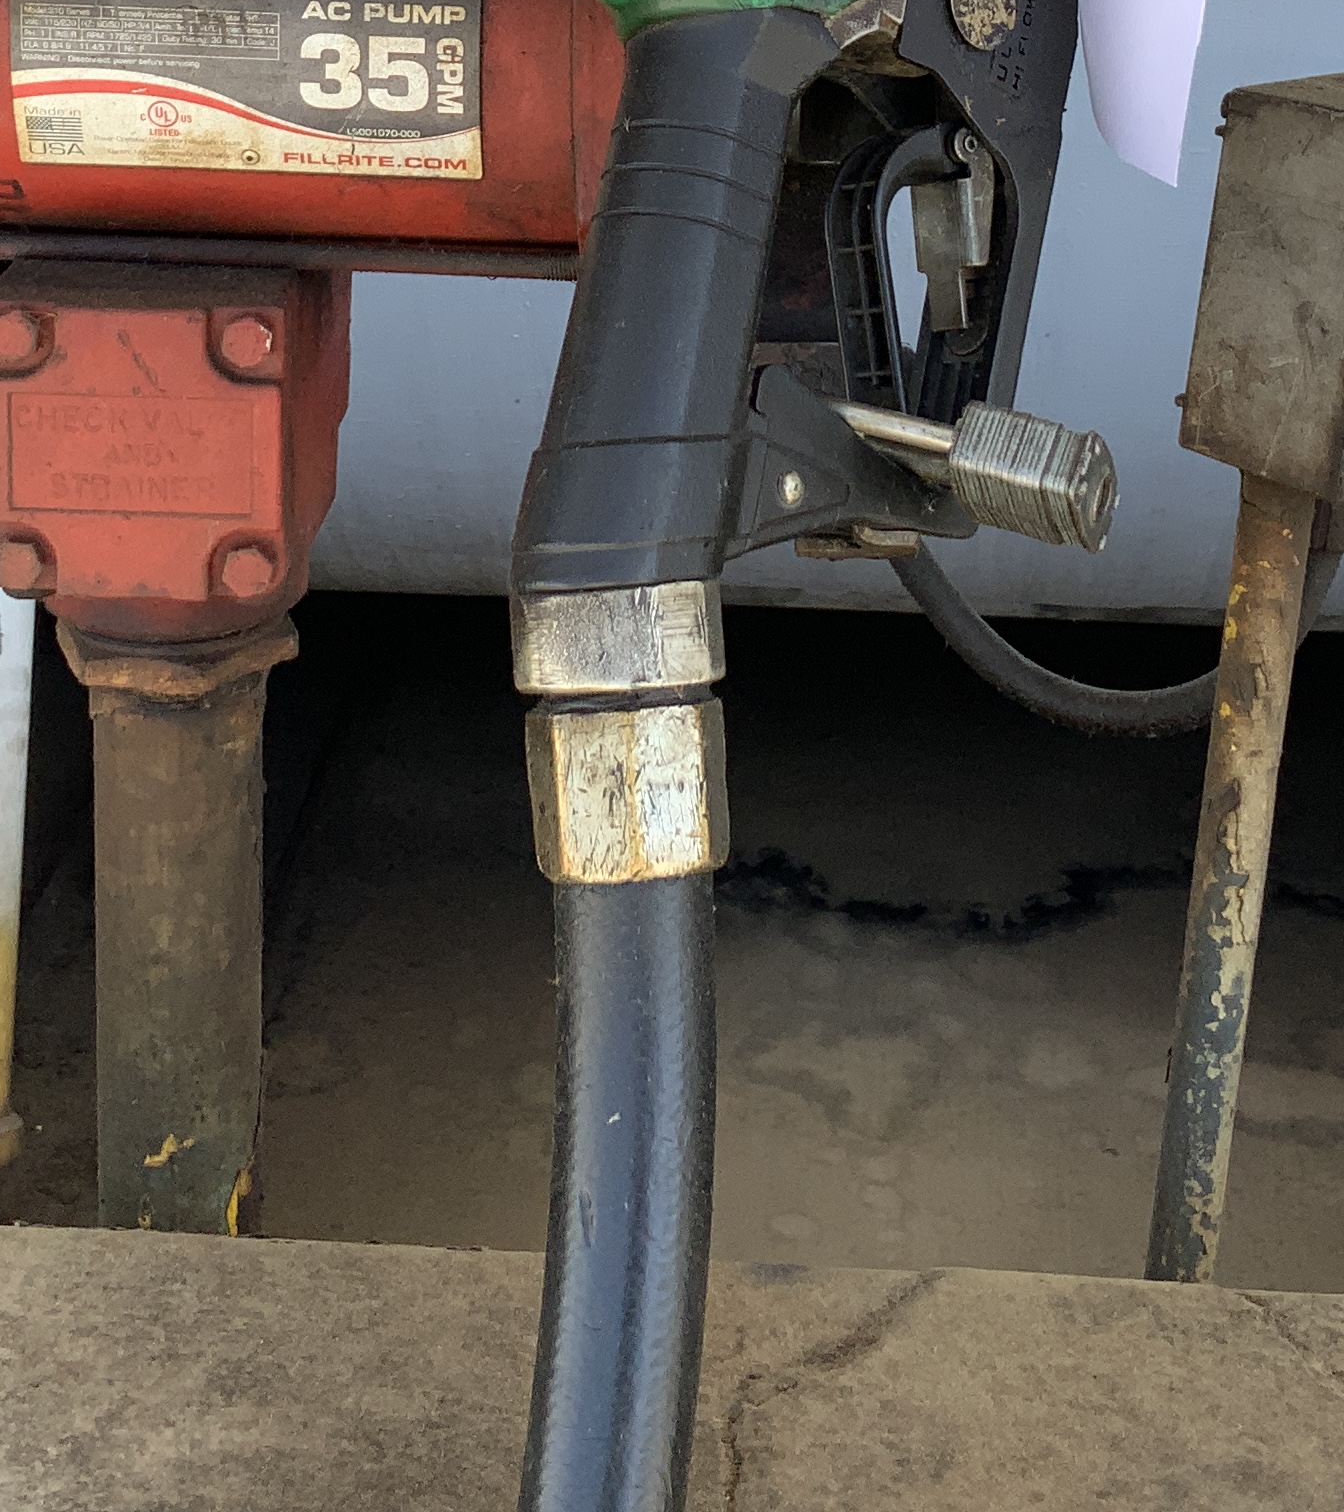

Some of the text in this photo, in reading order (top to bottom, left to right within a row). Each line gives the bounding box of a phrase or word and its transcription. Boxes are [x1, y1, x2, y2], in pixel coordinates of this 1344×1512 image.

[301, 1, 467, 25] AC PUMP
[299, 33, 464, 114] 35 GPM
[24, 106, 81, 116] Made in
[29, 143, 85, 155] USA
[283, 152, 467, 170] FILLRITE.COM
[15, 405, 127, 434] CHECK
